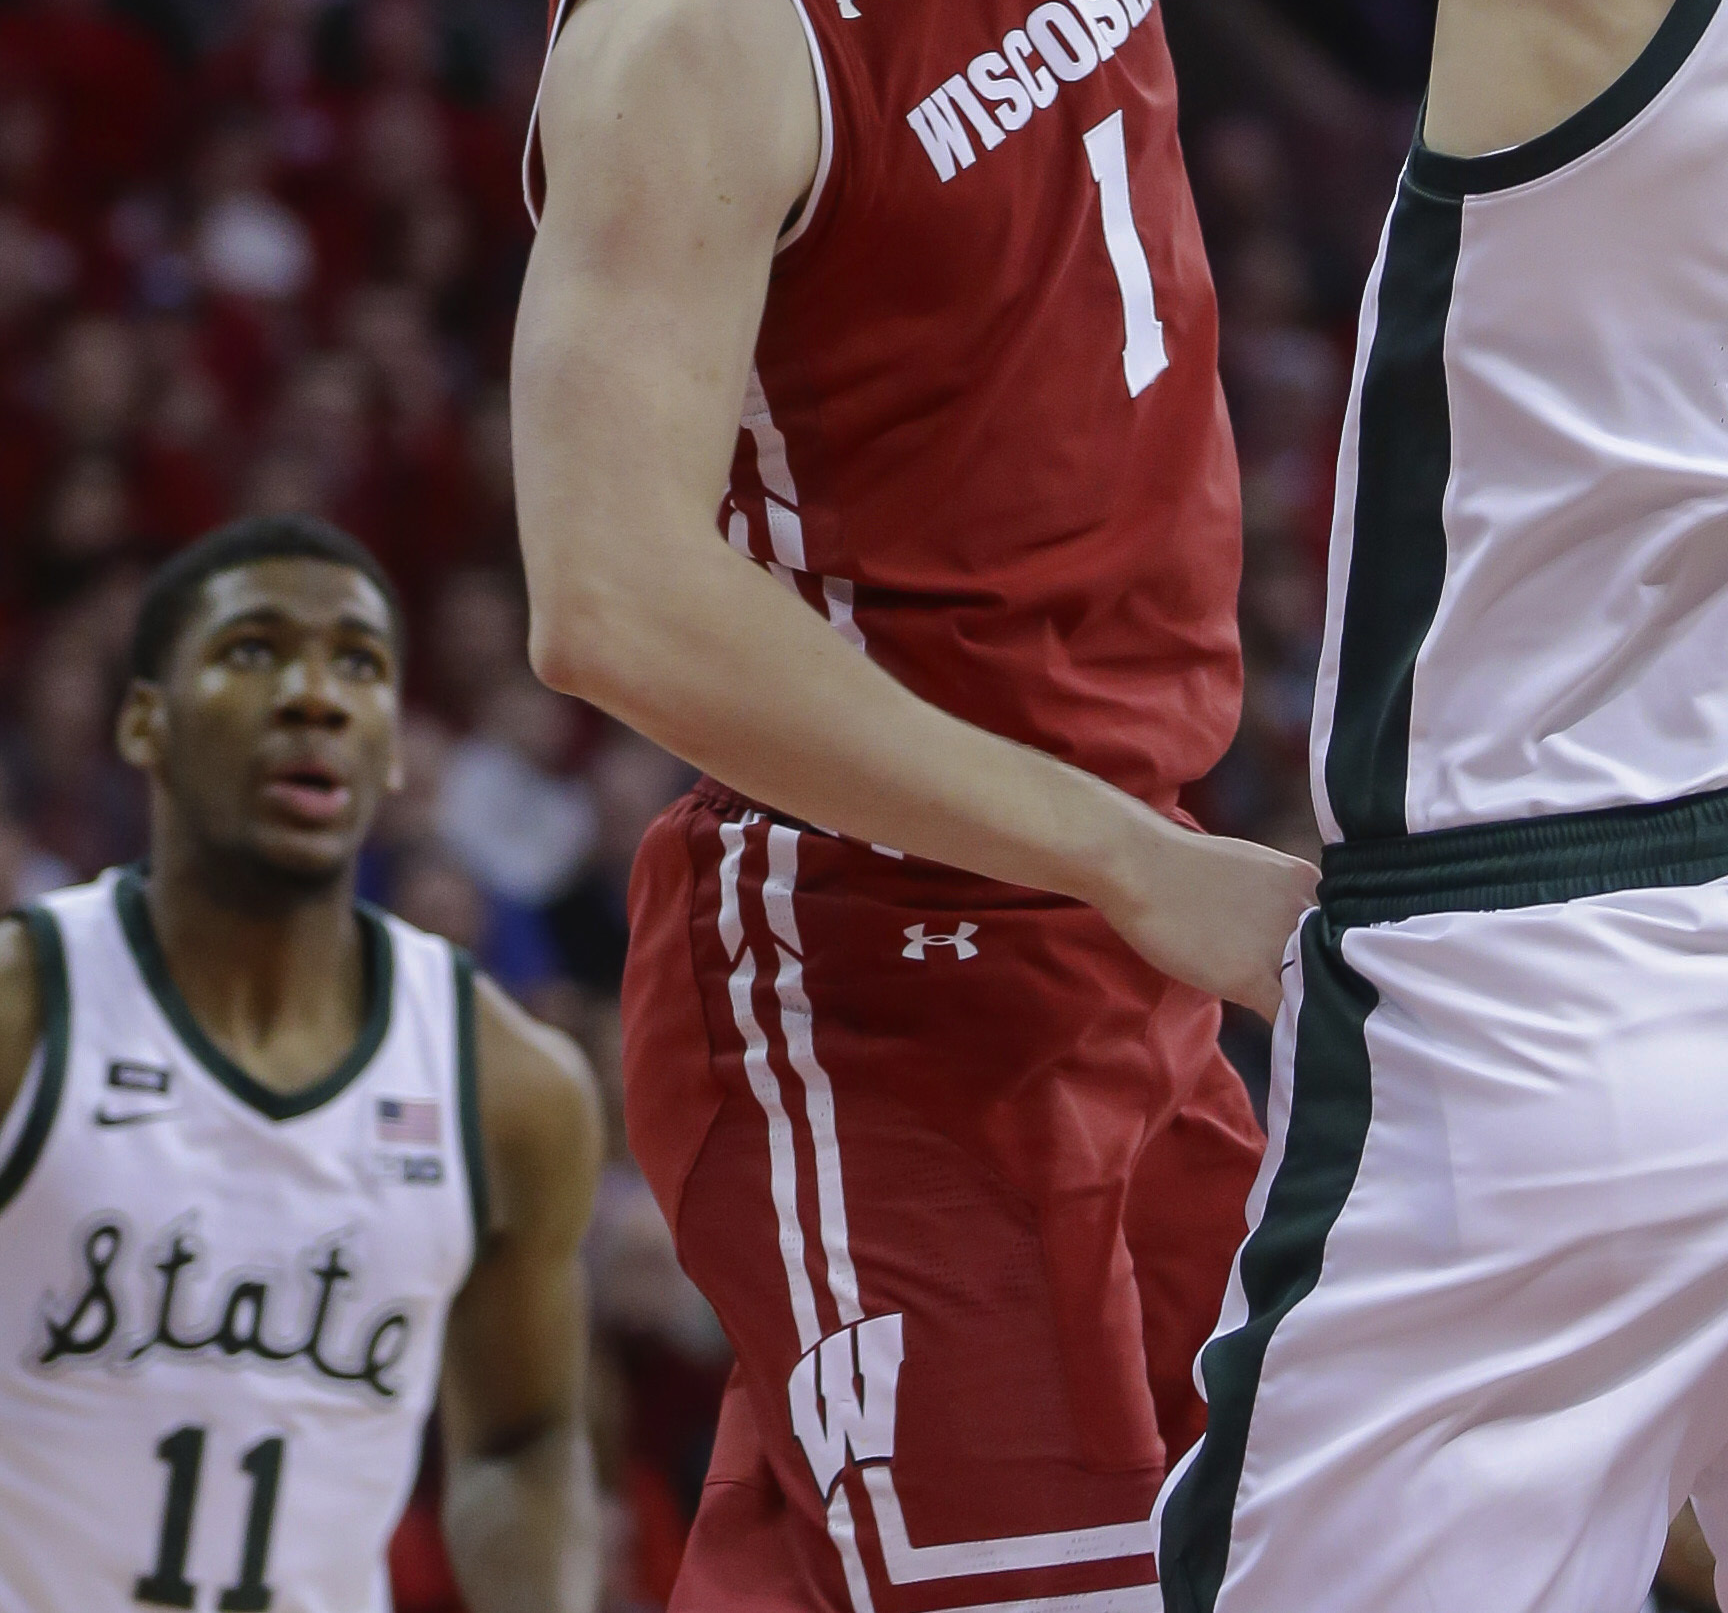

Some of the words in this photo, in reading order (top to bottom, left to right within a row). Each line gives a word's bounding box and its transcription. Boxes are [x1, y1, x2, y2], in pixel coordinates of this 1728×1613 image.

[1082, 108, 1170, 399] 1
[38, 1224, 408, 1397] State
[787, 1311, 906, 1503] W
[132, 1423, 287, 1613] 11
